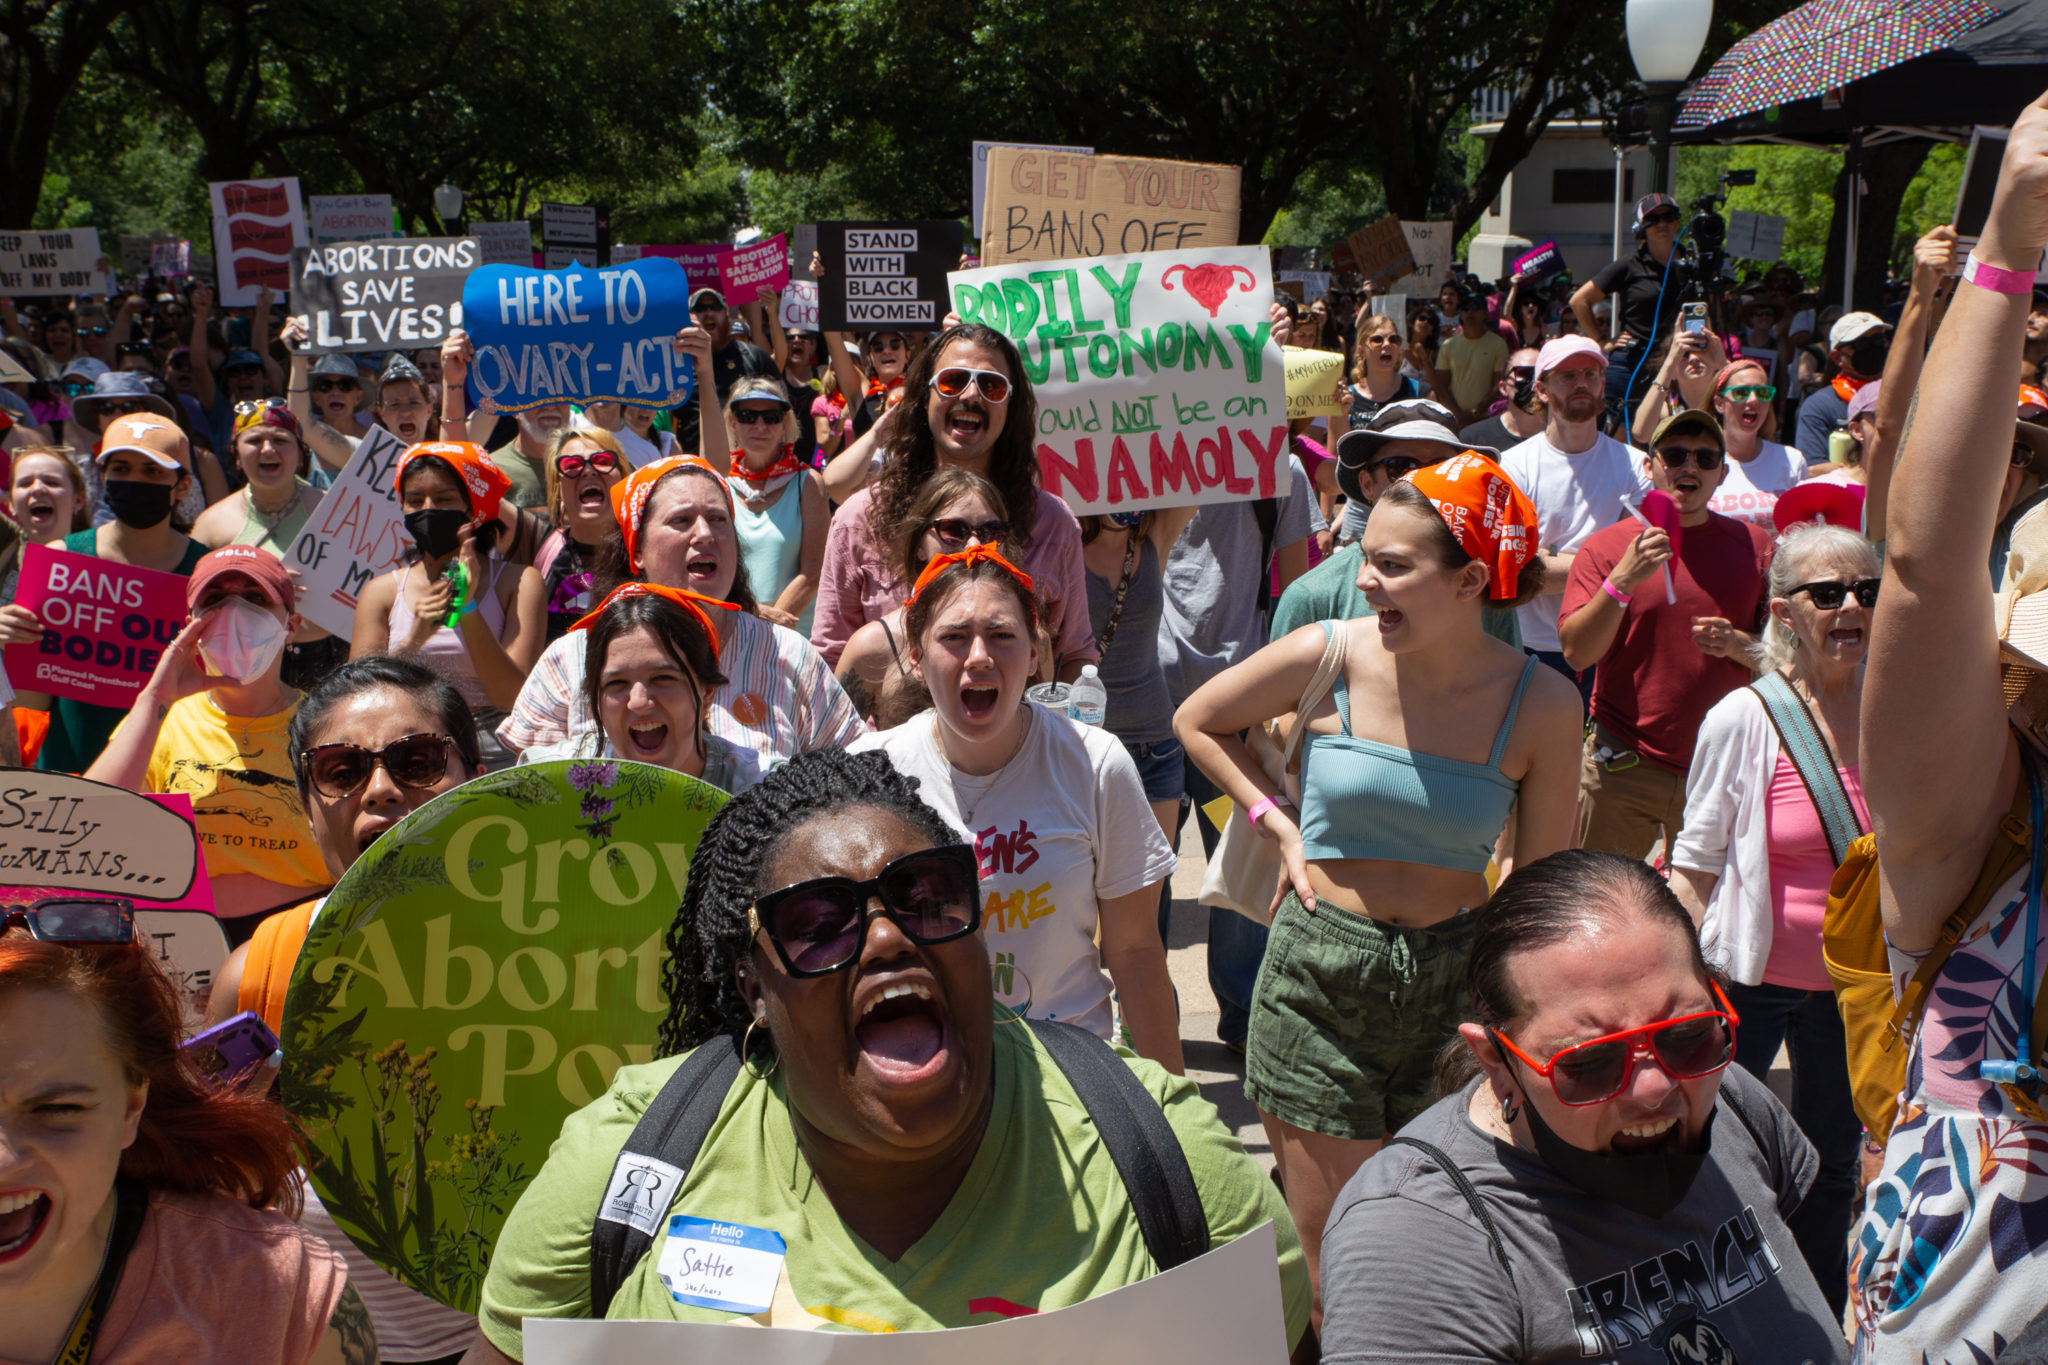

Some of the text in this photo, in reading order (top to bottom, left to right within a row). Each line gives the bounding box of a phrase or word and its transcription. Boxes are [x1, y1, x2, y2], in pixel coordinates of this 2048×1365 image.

[1010, 152, 1222, 213] GET YOUR
[321, 214, 387, 229] ABORTION
[1005, 205, 1208, 257] BANS OFF
[0, 233, 74, 252] EEP YOUR
[848, 232, 915, 249] STAND
[20, 252, 58, 269] LAWS
[303, 240, 476, 280] ABORTIONS
[726, 250, 785, 279] SAFE, LEGAL
[732, 242, 778, 266] PROTECT
[849, 257, 902, 272] WITH
[1, 270, 91, 289] OFF MY BODY
[687, 267, 704, 278] for
[732, 264, 784, 288] ABORTION
[1412, 264, 1434, 278] OT
[342, 275, 416, 306] SAVE
[498, 268, 647, 327] HERE TO
[783, 282, 819, 302] PROT
[849, 280, 913, 296] BLACK
[785, 303, 819, 325] CHO
[850, 303, 932, 320] WOMEN
[1017, 320, 1275, 386] UTONOMY
[1286, 355, 1340, 382] #MYUTERUS
[1296, 393, 1314, 408] ON
[1039, 391, 1268, 435] ould NOT be an
[355, 429, 410, 502] KE
[1036, 425, 1289, 505] NAMOLY
[1483, 475, 1503, 530] BODIES
[1706, 490, 1779, 513] ABOR
[321, 486, 403, 570] LAWS
[214, 548, 257, 559] #BLM
[297, 532, 330, 571] OF
[47, 562, 144, 608] BANS
[42, 597, 182, 645] OFF OU
[39, 629, 160, 674] BODIE
[51, 664, 140, 689] Planned Parenthood
[51, 674, 96, 691] Gulf Coast
[198, 832, 298, 850] VE TO TREAD
[311, 912, 671, 1013] Abort
[710, 1222, 745, 1240] Hello
[1565, 1204, 1783, 1358] FRENCH
